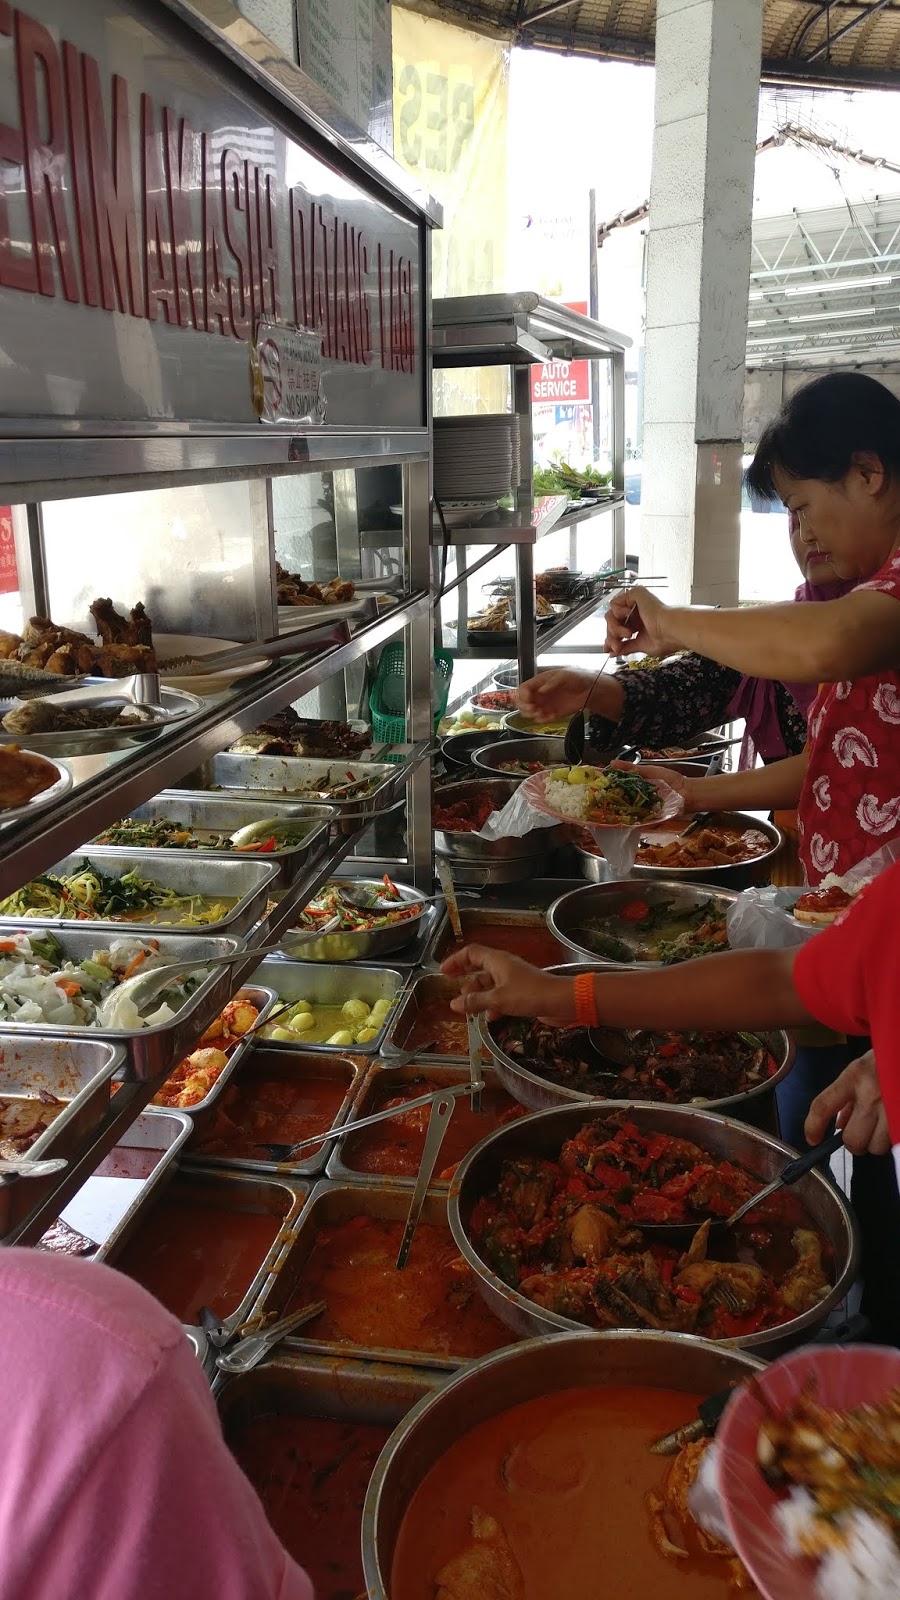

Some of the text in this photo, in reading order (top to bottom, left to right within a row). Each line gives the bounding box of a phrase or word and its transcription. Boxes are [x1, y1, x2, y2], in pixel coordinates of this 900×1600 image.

[288, 188, 373, 366] DATANG
[377, 243, 415, 374] LAGI
[541, 363, 570, 380] AUTO
[533, 379, 577, 398] SERVICE
